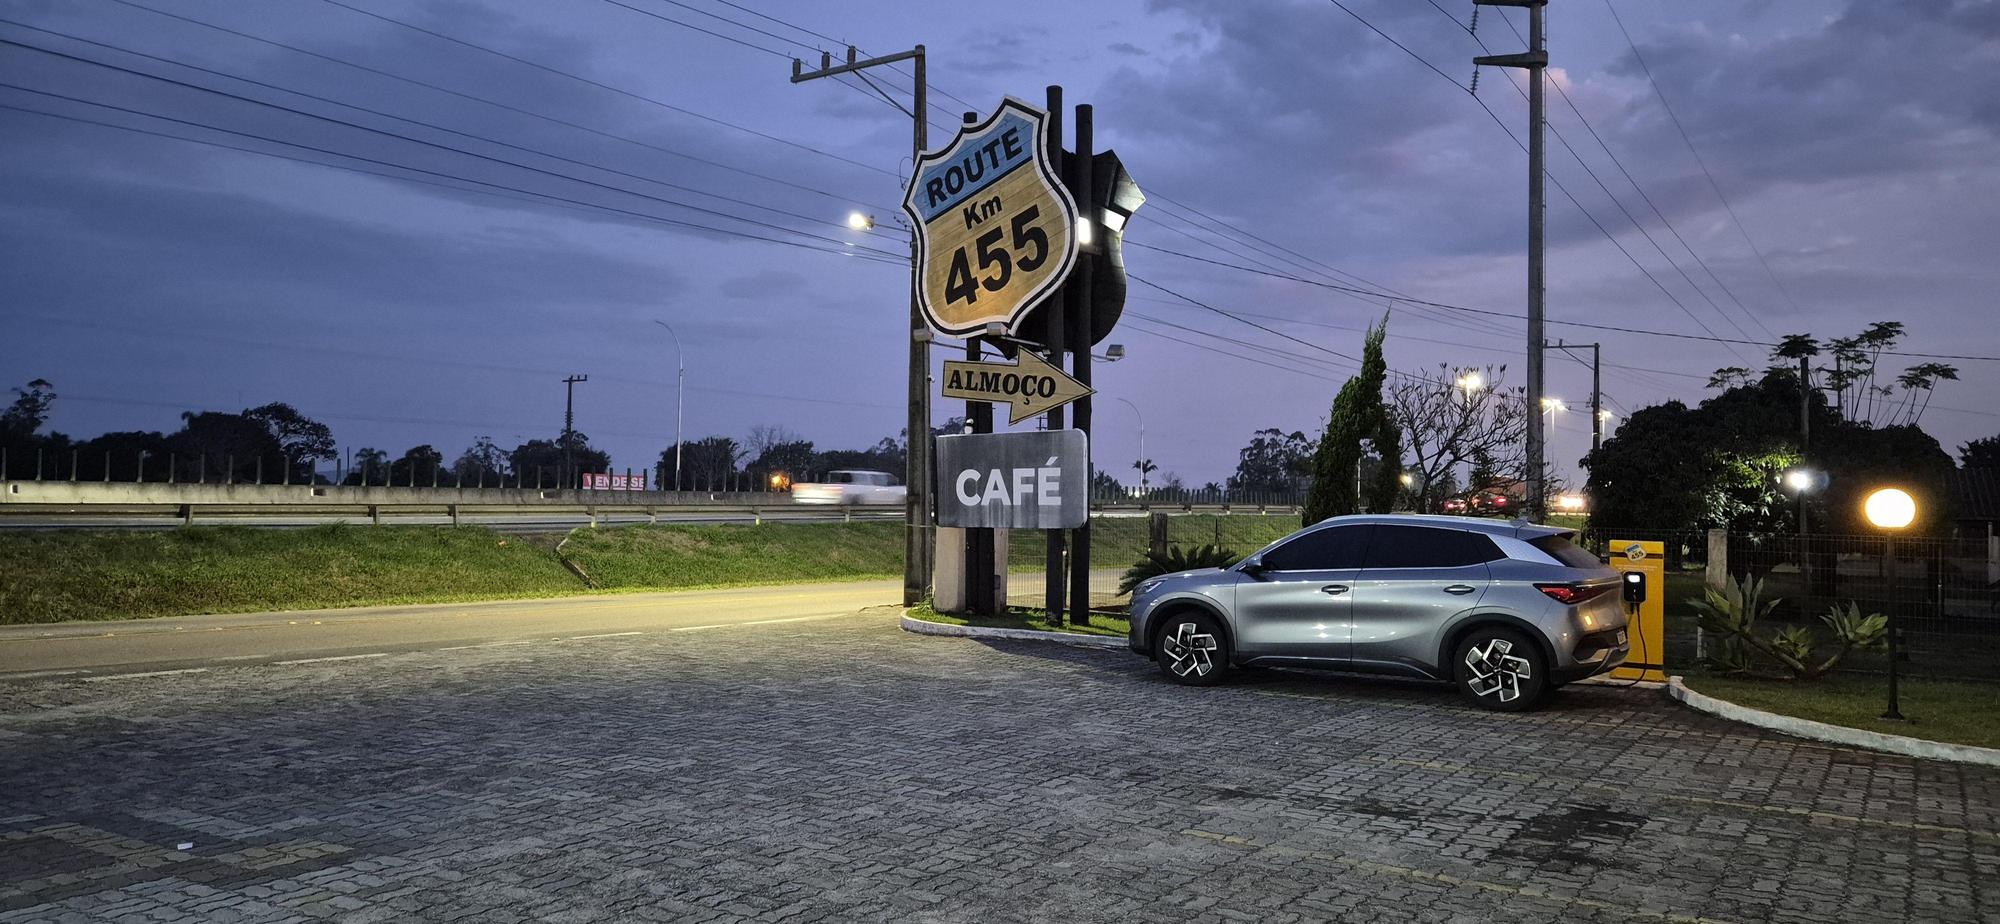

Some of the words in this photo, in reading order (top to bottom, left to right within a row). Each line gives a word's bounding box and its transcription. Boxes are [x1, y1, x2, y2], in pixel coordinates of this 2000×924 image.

[926, 126, 1022, 208] ROUTE
[963, 195, 1002, 230] Km
[944, 204, 1048, 305] 455
[947, 369, 1056, 406] ALMOÇO
[955, 456, 1062, 506] CAFÉ
